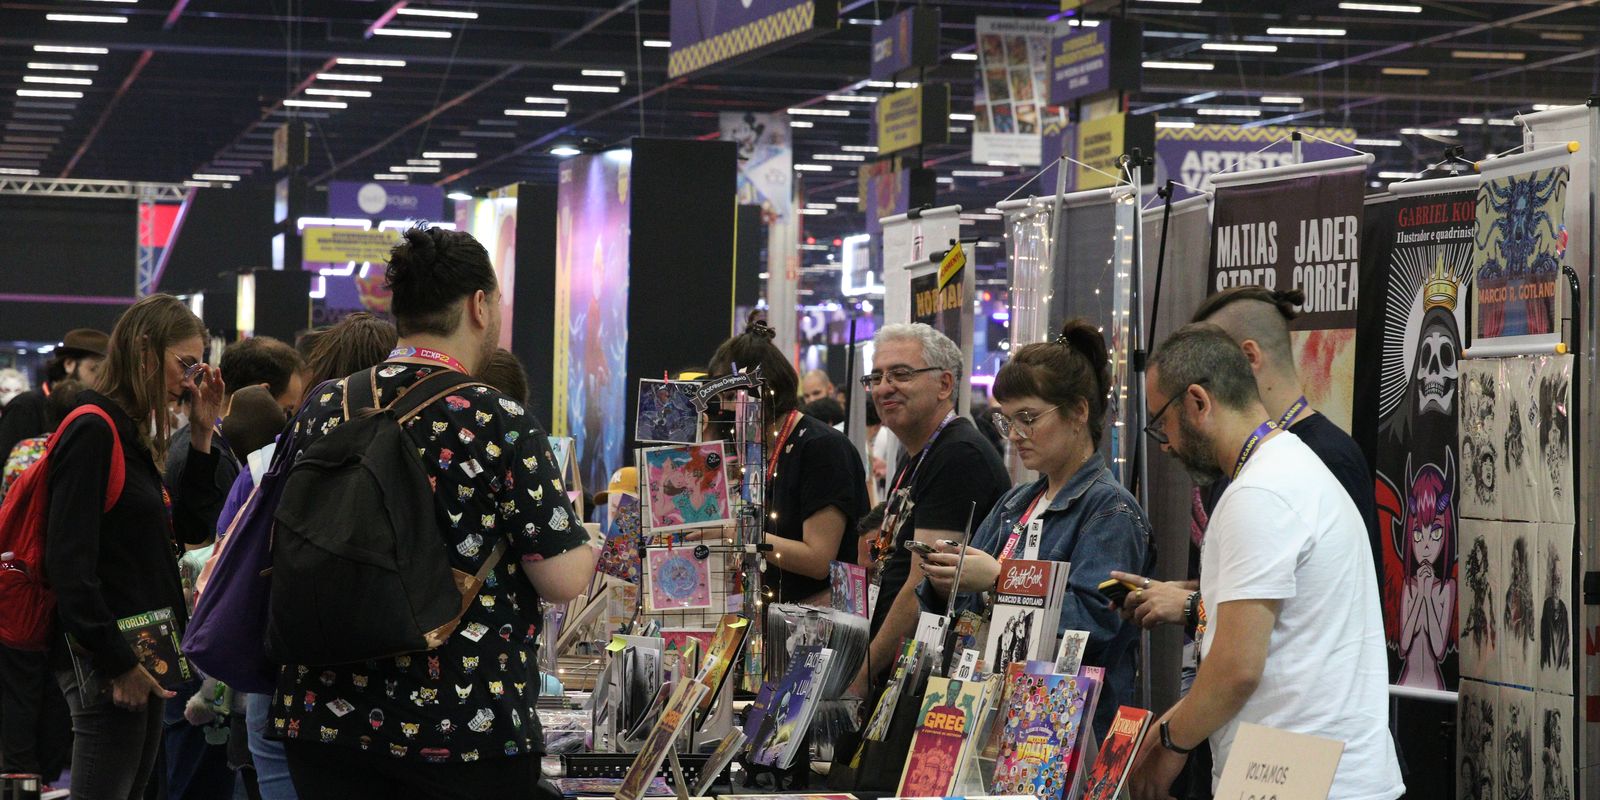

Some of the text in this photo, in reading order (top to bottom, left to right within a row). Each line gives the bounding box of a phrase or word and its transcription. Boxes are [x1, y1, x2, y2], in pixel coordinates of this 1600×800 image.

[1398, 203, 1448, 228] GABRIEL
[1216, 215, 1358, 268] MATIAS JADER
[1396, 229, 1430, 244] Ilustrador
[1430, 231, 1435, 240] e
[1292, 262, 1359, 313] CORREA
[1478, 287, 1507, 305] MARCIO
[1519, 281, 1555, 300] GOTLAND
[997, 594, 1017, 604] MARCIO
[1022, 596, 1044, 606] GOTLAND
[117, 614, 150, 631] WORLDS
[923, 712, 966, 733] GREG
[1245, 761, 1289, 785] VOLTAMOS
